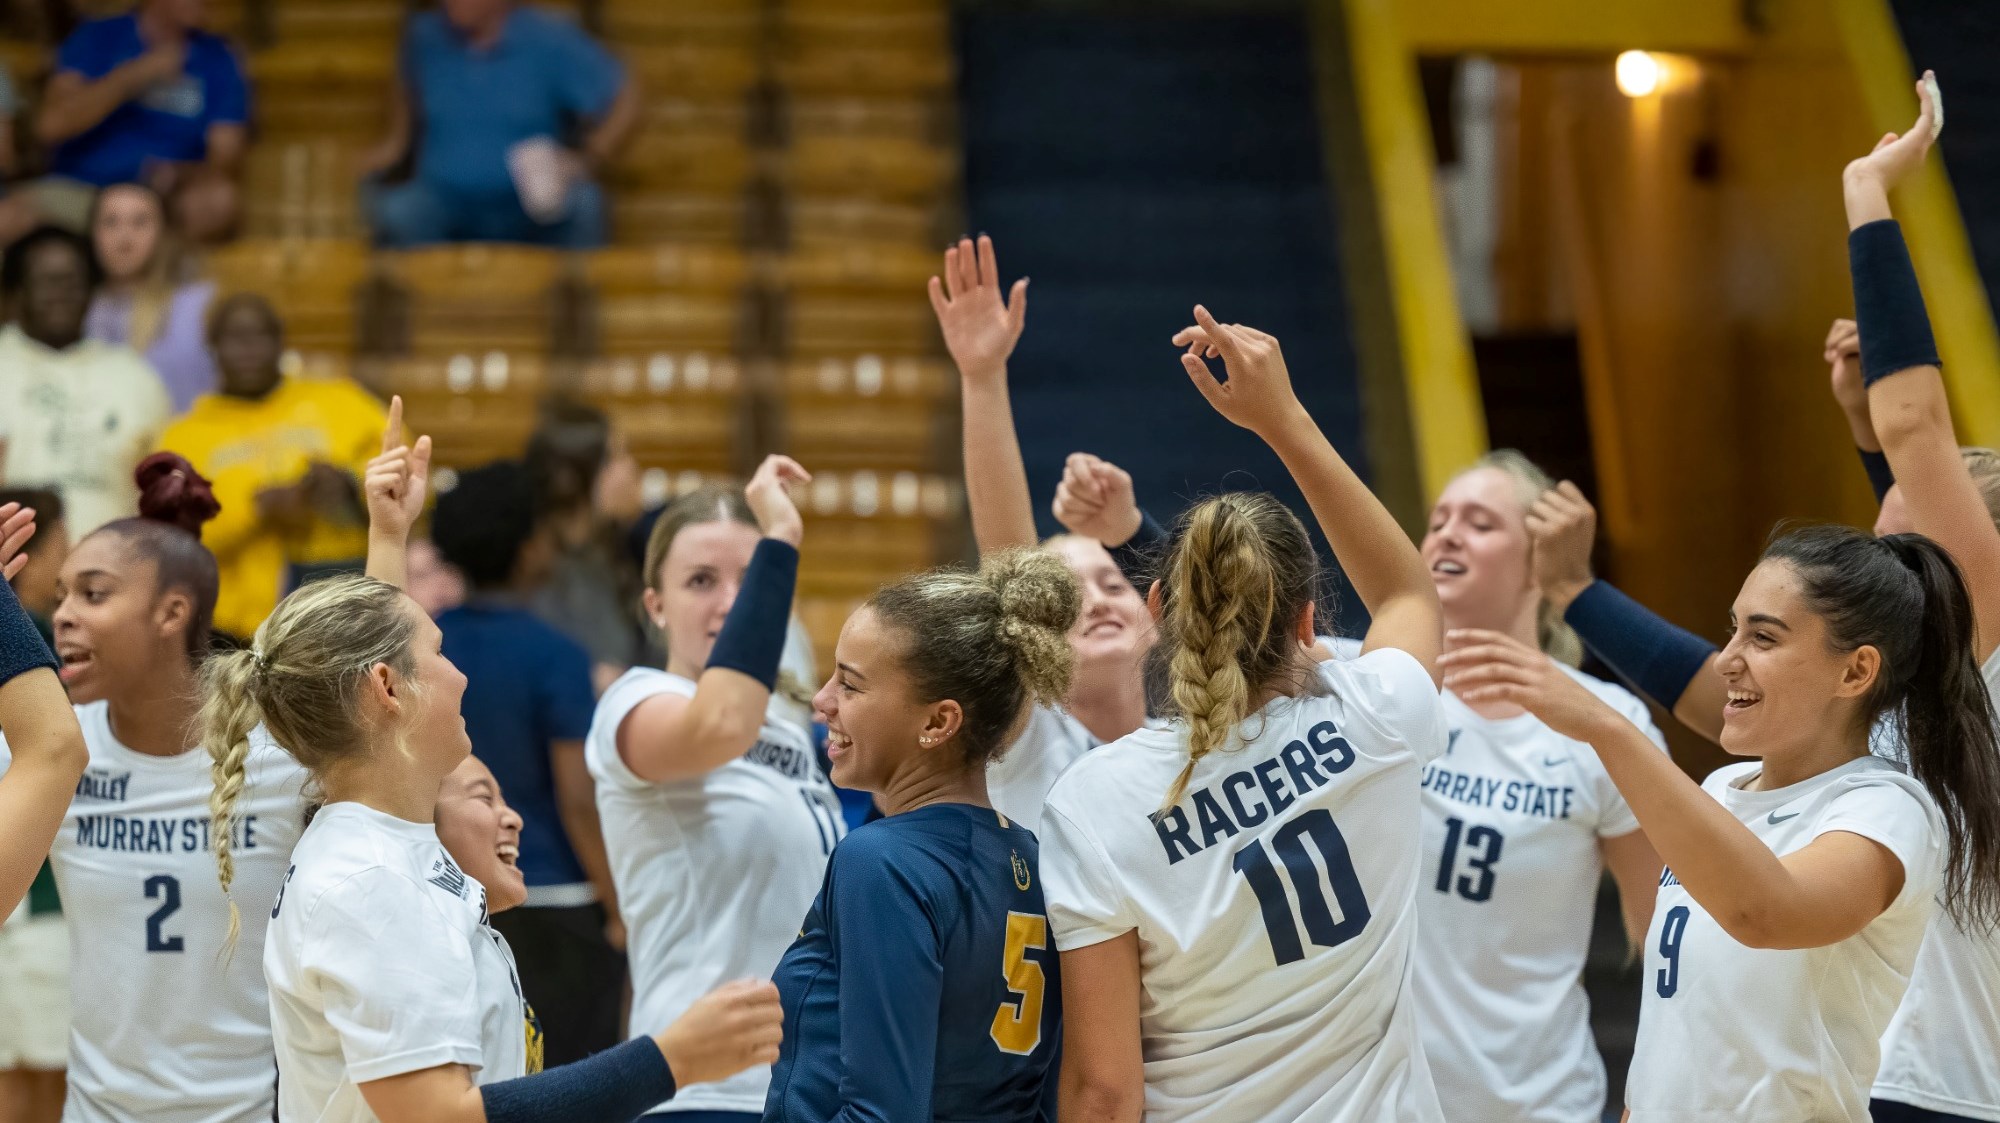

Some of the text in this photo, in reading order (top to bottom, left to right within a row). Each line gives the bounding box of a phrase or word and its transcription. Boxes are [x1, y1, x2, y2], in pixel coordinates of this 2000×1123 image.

[76, 814, 258, 854] MURRAY STTE
[1147, 720, 1356, 866] RACERS
[1421, 766, 1574, 819] URRAY STATE
[1232, 808, 1371, 967] 10
[1435, 817, 1504, 903] 13
[144, 875, 184, 952] 2
[1656, 905, 1691, 999] 9
[989, 911, 1047, 1056] 5
